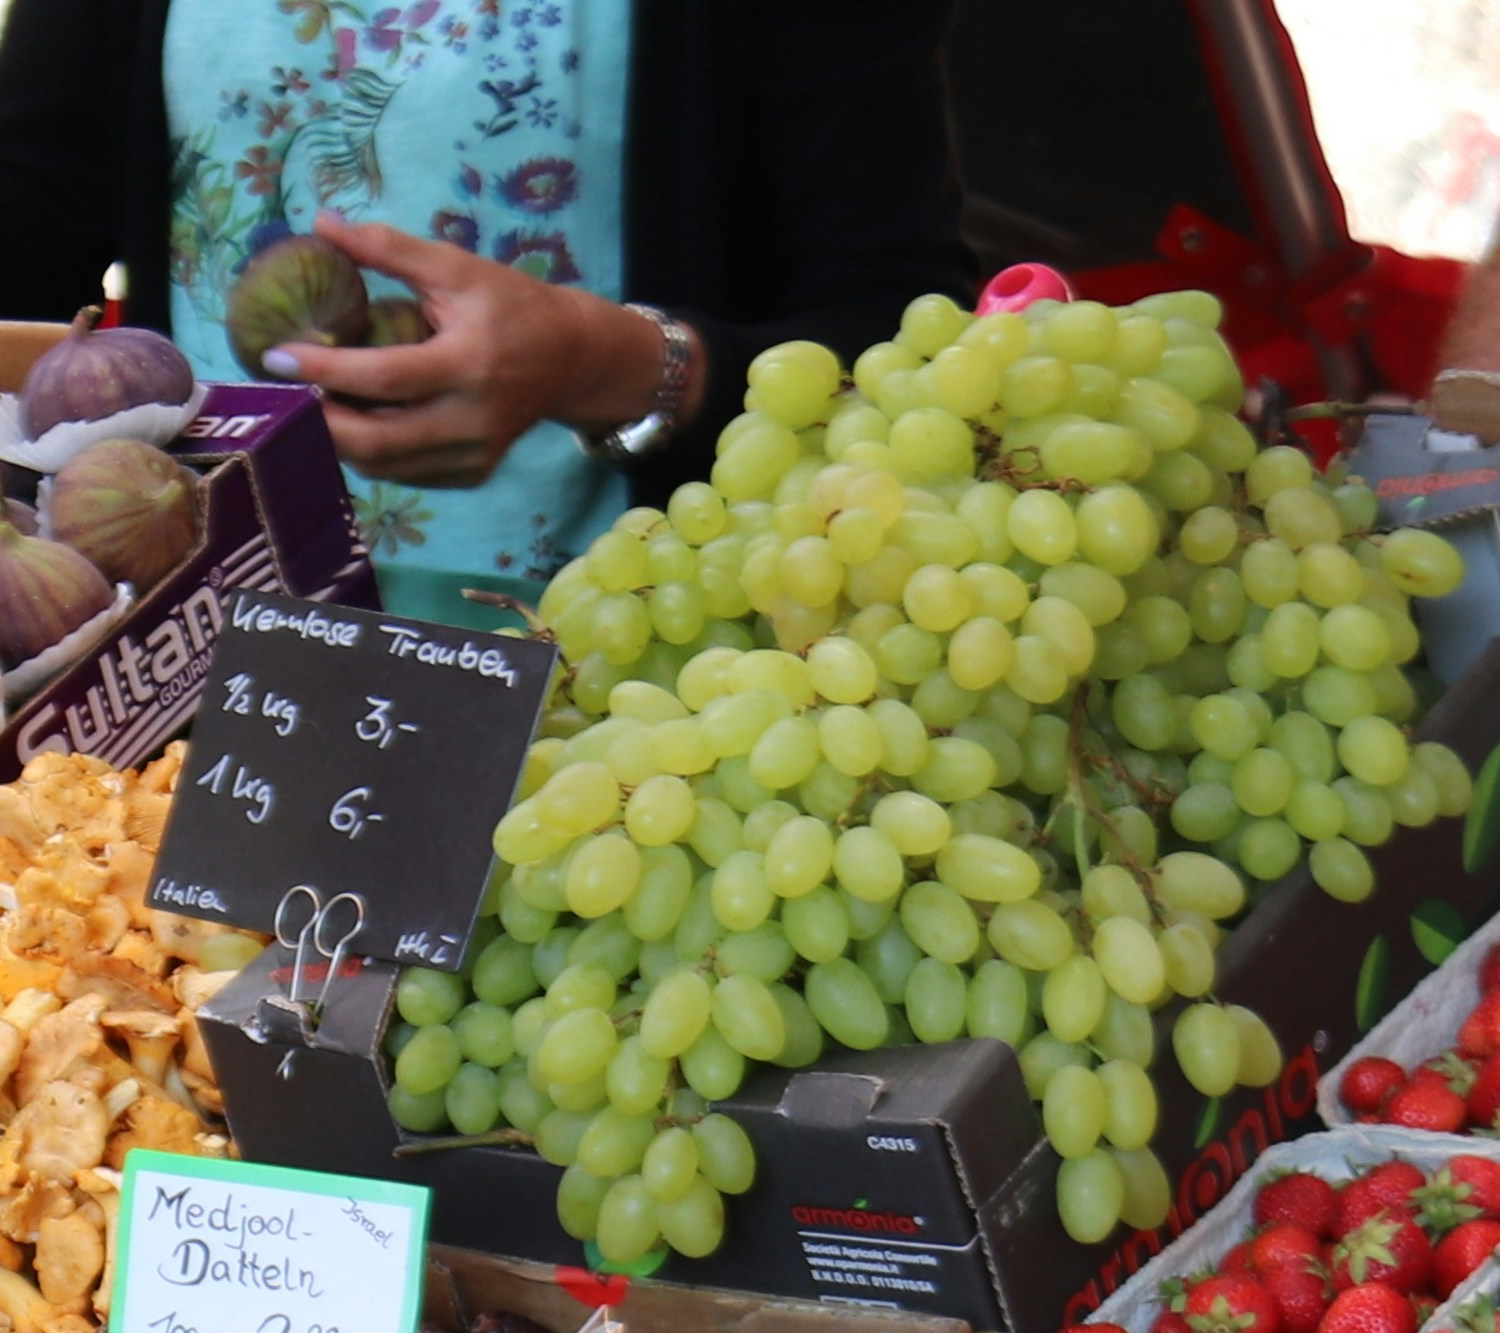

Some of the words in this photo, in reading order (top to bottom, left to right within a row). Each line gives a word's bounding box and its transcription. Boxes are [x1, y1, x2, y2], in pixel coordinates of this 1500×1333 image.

[231, 594, 360, 648] Kernlose
[378, 623, 519, 689] Trauben
[261, 691, 299, 737] kg
[354, 695, 419, 750] 3,-
[196, 753, 232, 795] 1
[231, 765, 275, 825] kg
[328, 786, 385, 841] 6,-
[152, 876, 228, 914] Italien
[866, 1135, 917, 1152] C4315
[147, 1185, 313, 1250] Medjool-
[791, 1204, 918, 1235] armonia
[157, 1237, 325, 1299] Datteln
